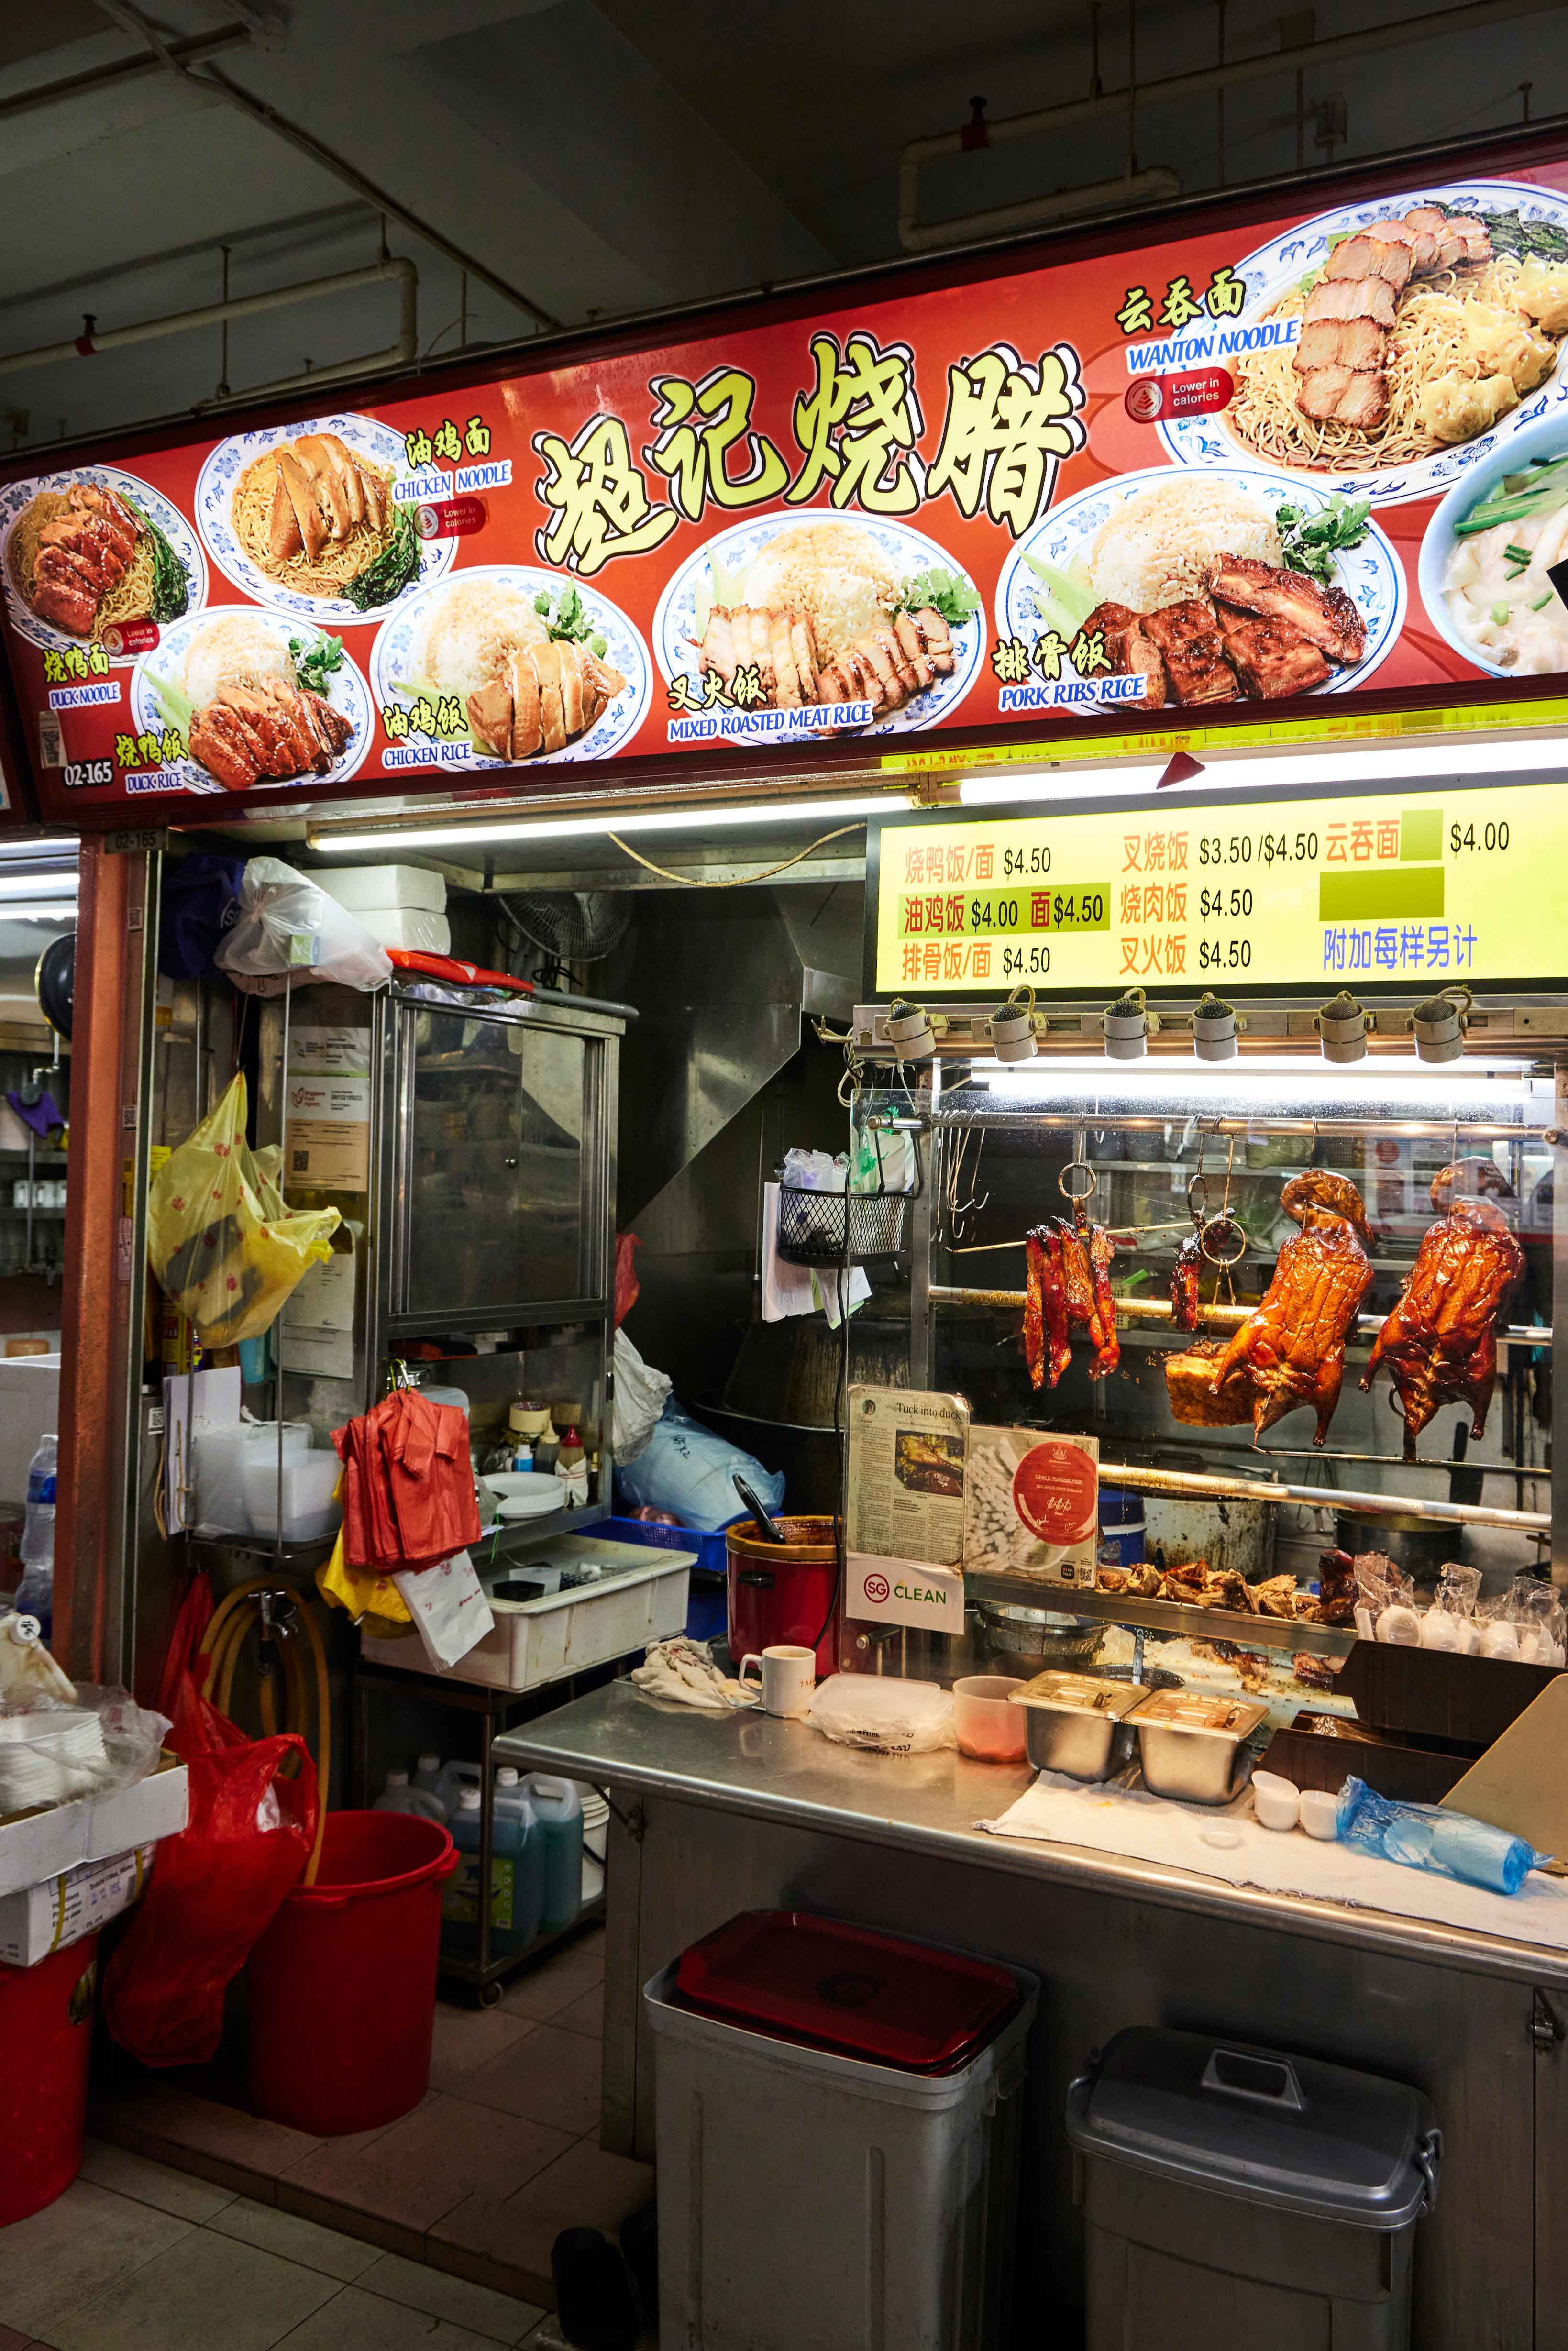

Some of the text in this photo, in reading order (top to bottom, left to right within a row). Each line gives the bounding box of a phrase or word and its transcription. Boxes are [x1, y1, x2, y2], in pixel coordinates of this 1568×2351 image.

[1116, 266, 1246, 334] 云吞面
[1129, 320, 1299, 369] WANTON NOODLE
[1172, 378, 1219, 394] Lower in
[1173, 392, 1219, 406] calories
[406, 416, 490, 469] 油鸡面
[395, 464, 509, 500] CHICKEN NOODLE
[444, 508, 466, 518] Lower
[445, 518, 476, 527] calories
[44, 643, 109, 683] 烧鸭面
[992, 629, 1112, 683] 排骨饭
[51, 684, 118, 706] DUCK NOODLE
[668, 665, 767, 711] 叉火饭
[1002, 677, 1145, 708] PORK RIBS RICE
[383, 696, 468, 740] 油鸡饭
[670, 704, 871, 739] MIXED ROASTED MEAT RICE
[115, 729, 188, 767] 烧鸭饭
[384, 743, 471, 766] CHICKEN RICE
[65, 762, 113, 785] 02-165
[128, 772, 183, 791] DUCK RICE
[115, 831, 156, 849] 02-165
[1122, 831, 1189, 873] 叉烧饭
[1200, 835, 1251, 871] $3.50
[1326, 819, 1510, 862] 云吞面 $4.00
[905, 844, 1051, 883] 烧鸭饭/面 $4.50
[904, 894, 965, 934] 油鸡饭
[972, 897, 1018, 932] $4.00
[1054, 894, 1103, 929] $4.50
[1120, 883, 1253, 924] 烧肉饭 $4.50
[902, 942, 1050, 981] 排骨饭/面 $4.50
[1119, 934, 1251, 976] 叉火饭 $4.50
[1324, 924, 1478, 970] 附加每样另计
[897, 1402, 961, 1420] Tuck into duck
[867, 1581, 946, 1604] SG CLEAN
